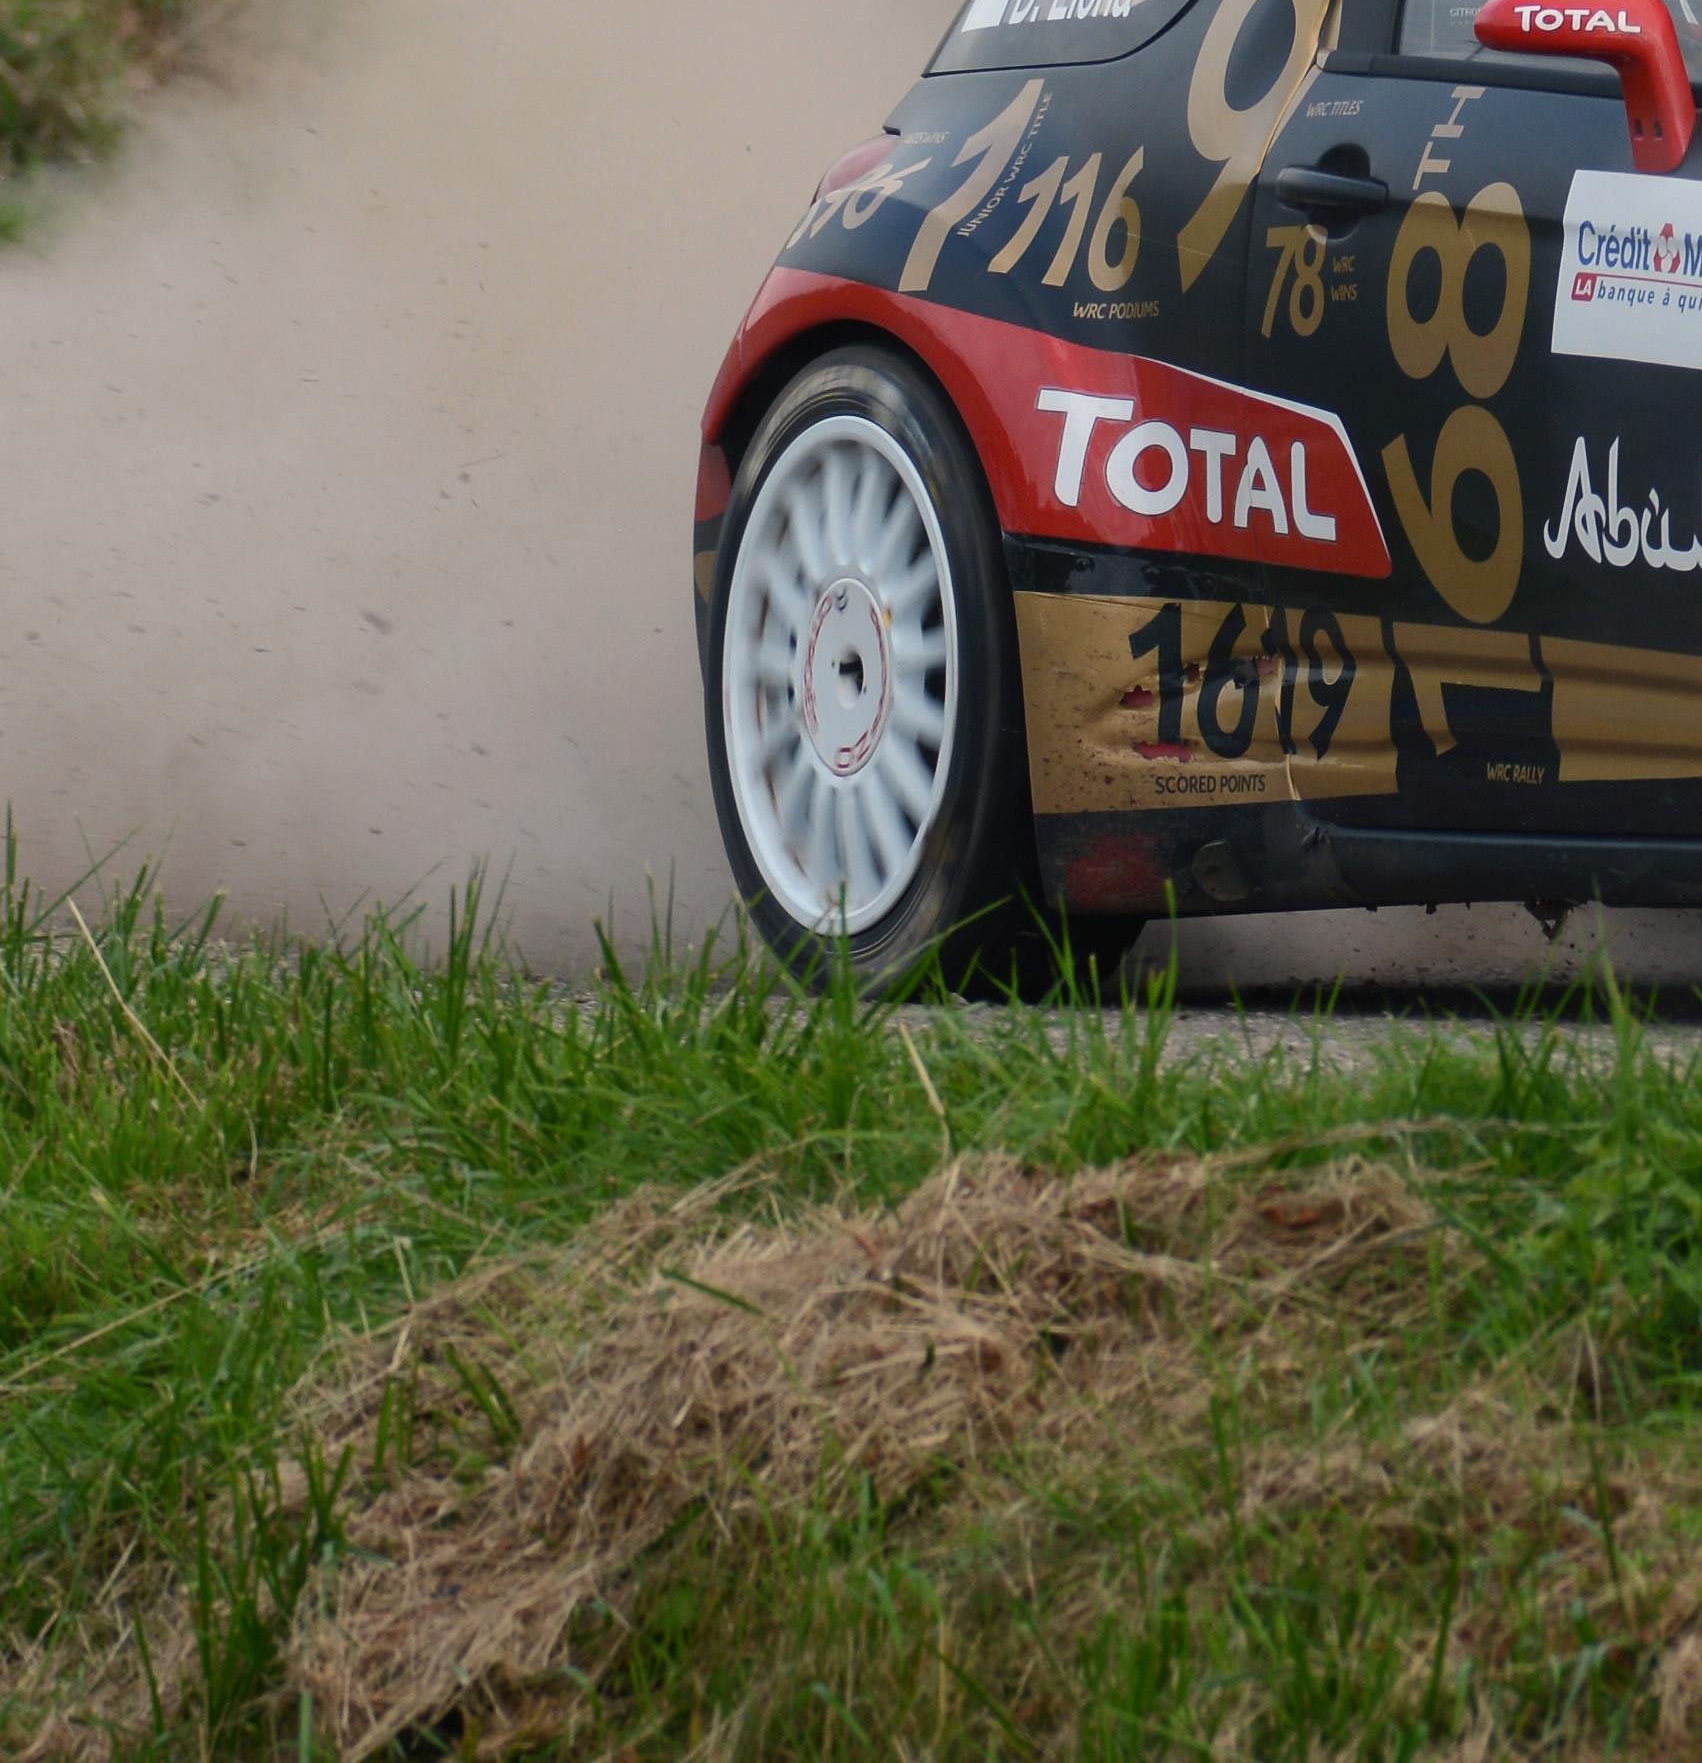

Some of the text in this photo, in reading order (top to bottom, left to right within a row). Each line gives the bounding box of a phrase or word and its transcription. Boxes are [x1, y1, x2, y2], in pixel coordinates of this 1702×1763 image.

[1512, 3, 1641, 35] TOTAL
[1306, 102, 1333, 119] WRC
[956, 91, 1054, 237] JUNIOR WRC TITLE
[898, 78, 1046, 293] 1
[987, 145, 1144, 292] 116
[1578, 219, 1652, 271] Crédit
[1333, 255, 1357, 273] WRC
[1261, 226, 1326, 339] 78
[1331, 283, 1358, 302] WINS
[1575, 278, 1593, 297] LA
[1597, 280, 1656, 308] banque
[1073, 300, 1161, 320] WRC PODIUMS
[1035, 387, 1338, 542] TOTAL
[1128, 602, 1357, 762] 1619
[1155, 773, 1267, 795] SCORED POINTS
[1487, 762, 1547, 786] WRC RALLY
